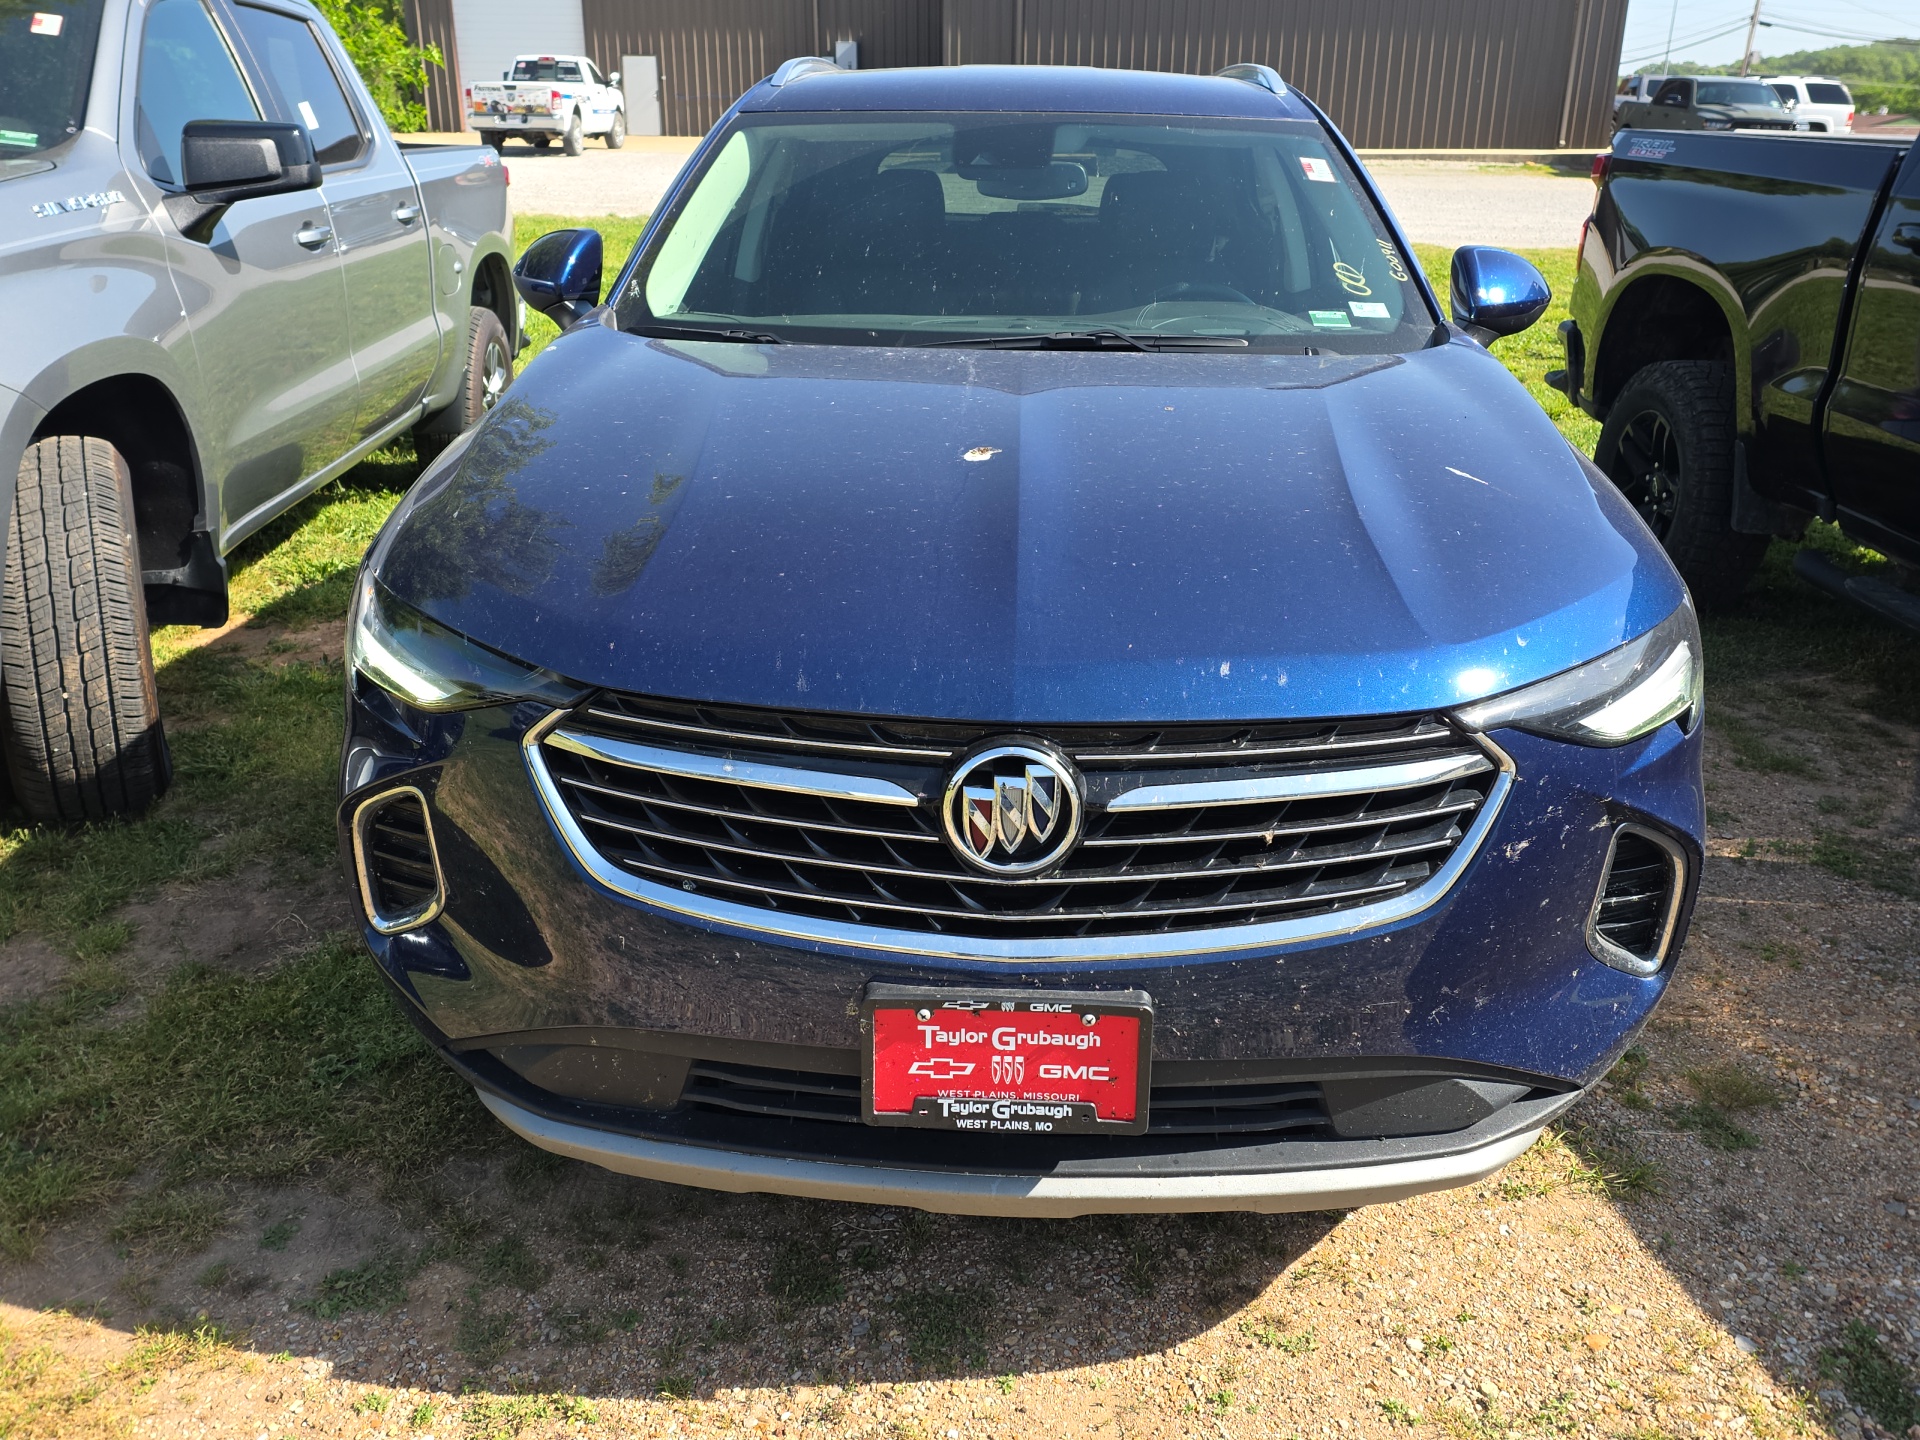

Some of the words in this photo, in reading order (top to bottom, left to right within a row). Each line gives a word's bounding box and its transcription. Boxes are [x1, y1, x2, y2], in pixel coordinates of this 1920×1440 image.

[1630, 138, 1677, 153] TRAIL
[1627, 148, 1668, 160] BOSS
[1029, 1002, 1072, 1013] GMC
[917, 1025, 988, 1048] Taylor
[991, 1027, 1101, 1051] Grubaugh
[1039, 1064, 1110, 1081] GMC
[937, 1089, 971, 1099] WEST
[974, 1090, 1020, 1101] PLAINS,
[1023, 1091, 1080, 1102] MISSOURI
[937, 1099, 990, 1118] Taylor
[991, 1100, 1073, 1119] Grubaugh
[956, 1119, 988, 1129] WEST
[990, 1120, 1033, 1132] PLAINS,
[1035, 1122, 1053, 1132] MO
